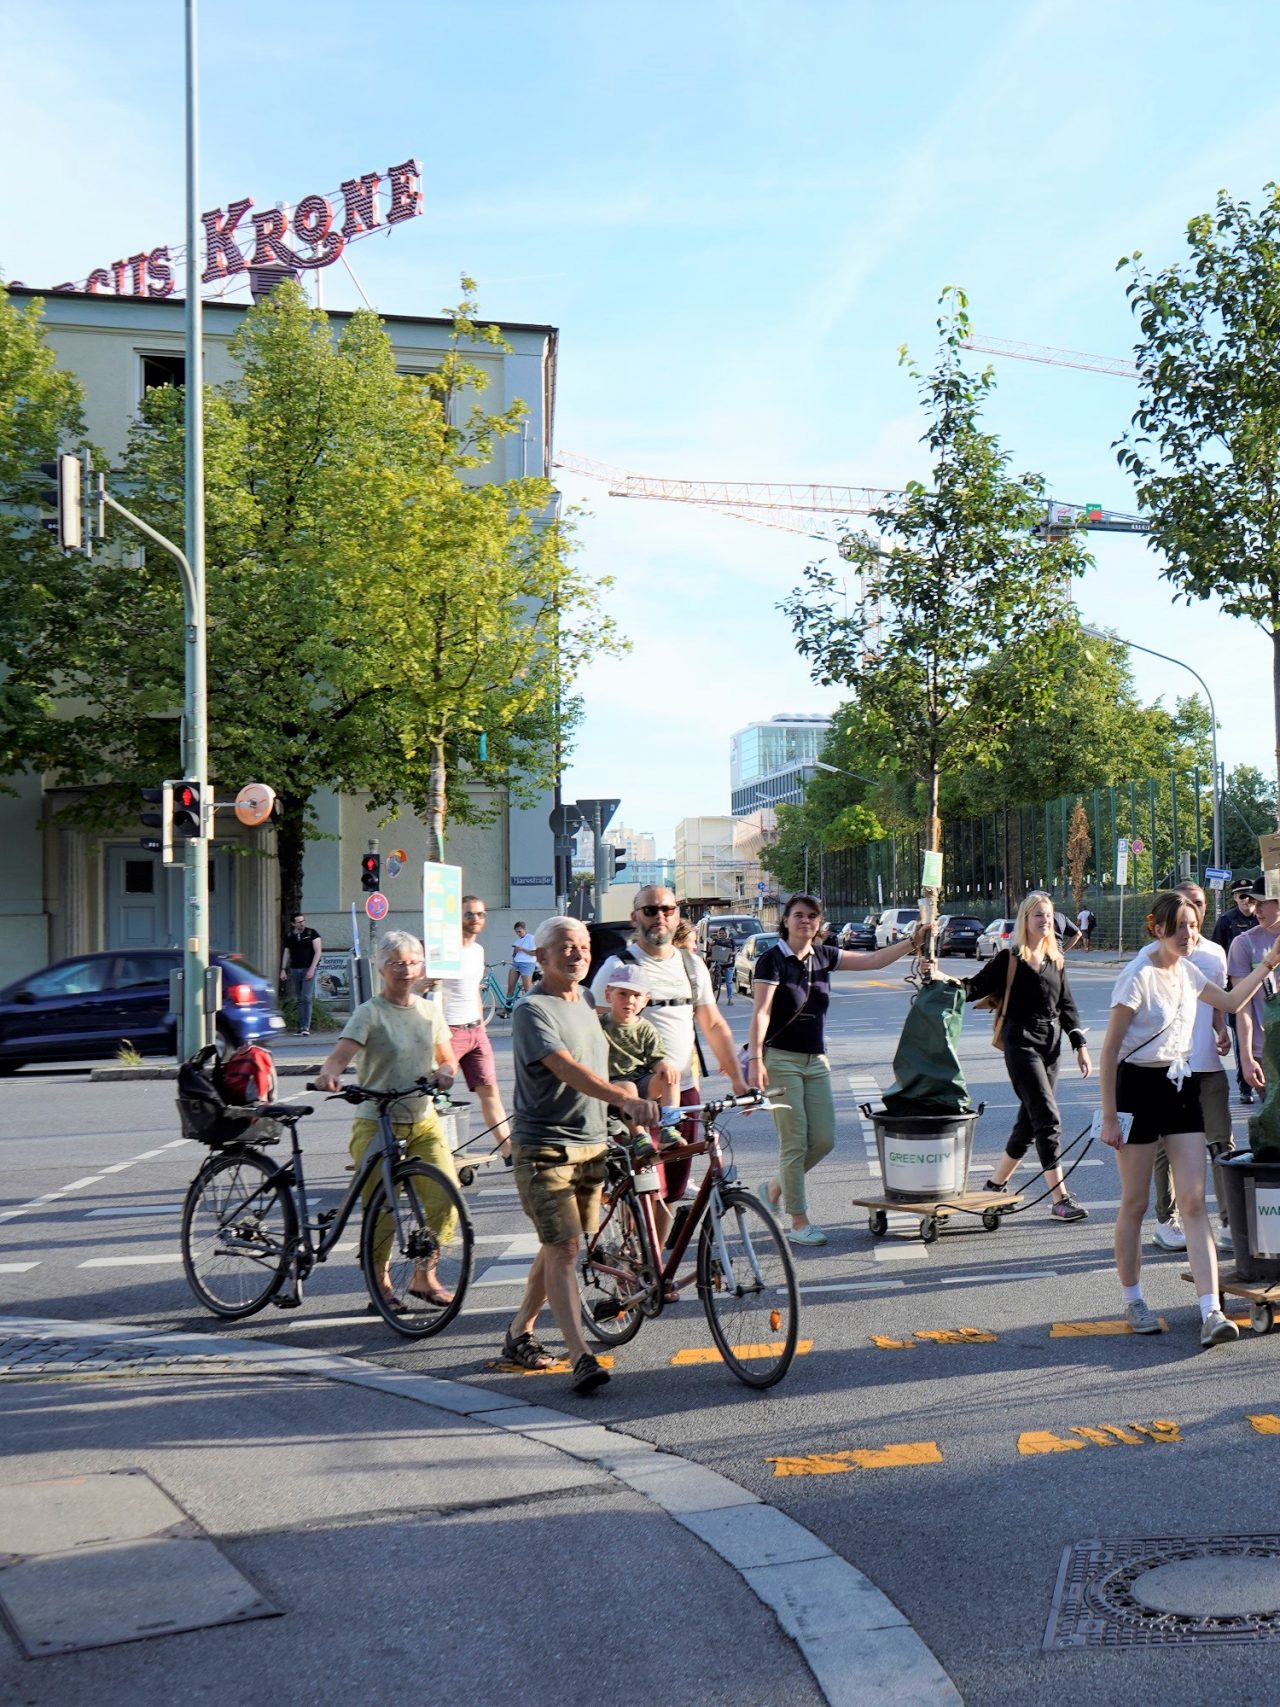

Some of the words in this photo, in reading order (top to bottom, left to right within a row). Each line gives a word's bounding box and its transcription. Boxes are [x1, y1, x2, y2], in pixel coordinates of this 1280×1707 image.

[201, 158, 423, 285] KRONE
[889, 1151, 924, 1164] GREEN
[926, 1151, 952, 1164] CITY
